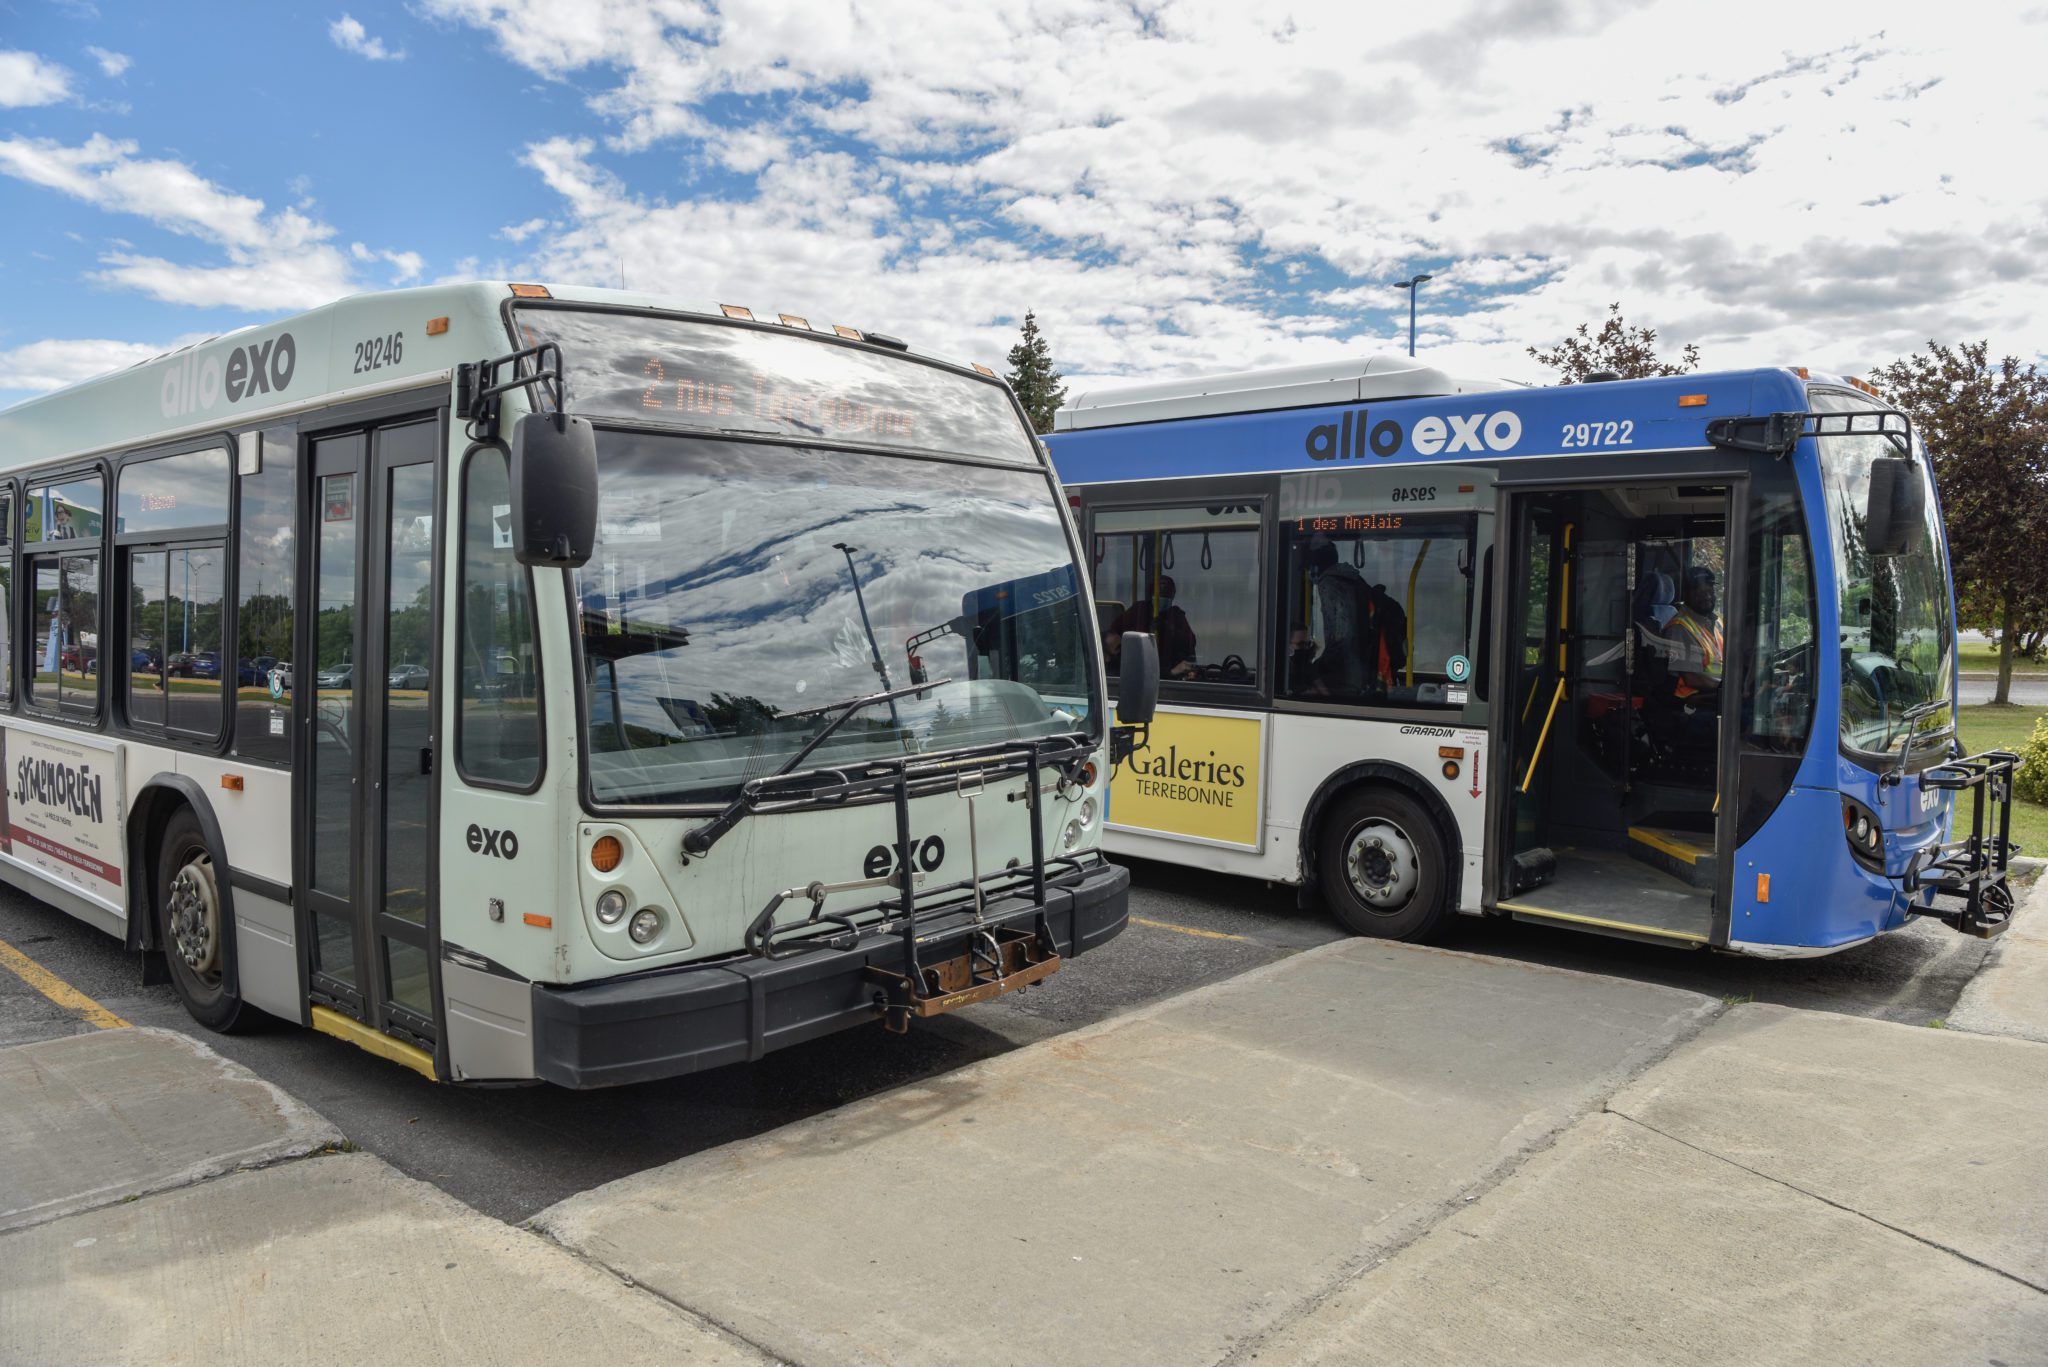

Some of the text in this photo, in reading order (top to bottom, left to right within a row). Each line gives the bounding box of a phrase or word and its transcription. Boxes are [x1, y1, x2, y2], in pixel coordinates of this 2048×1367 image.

[353, 331, 404, 374] 29246
[161, 332, 297, 419] allo exo
[643, 357, 664, 408] 2
[1305, 409, 1522, 462] allo exo
[1561, 420, 1634, 449] 29722
[1298, 513, 1402, 531] 1 des Anglais
[1400, 725, 1456, 738] GIRARDIN
[1128, 744, 1245, 788] Galeries
[1136, 779, 1234, 807] TERREBONNE
[466, 823, 519, 860] exo
[863, 834, 945, 880] exo
